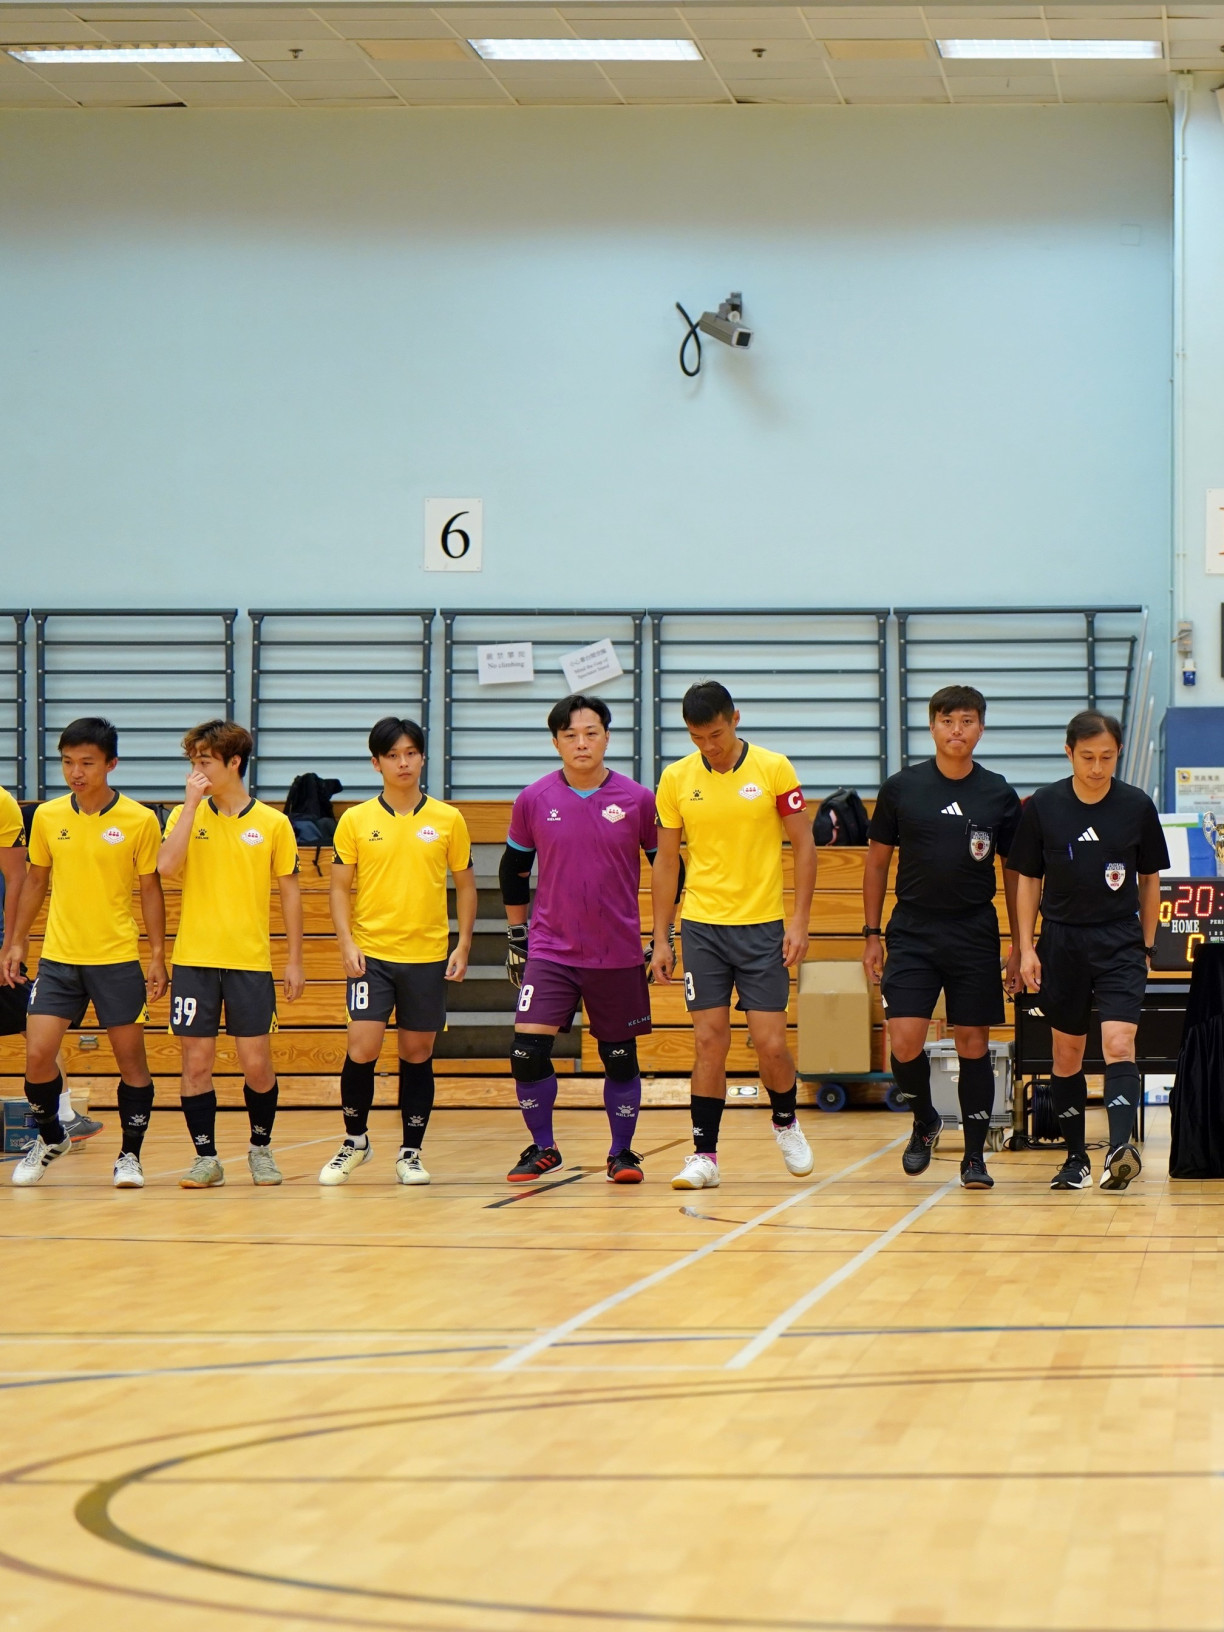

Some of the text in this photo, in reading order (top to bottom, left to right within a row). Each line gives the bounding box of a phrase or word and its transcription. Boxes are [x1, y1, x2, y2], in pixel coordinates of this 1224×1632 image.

[441, 510, 470, 559] 6
[788, 791, 803, 809] C
[1159, 901, 1173, 923] 0
[1171, 919, 1200, 933] HOME
[351, 981, 369, 1011] 18
[173, 996, 197, 1026] 39
[627, 1014, 652, 1027] KELME
